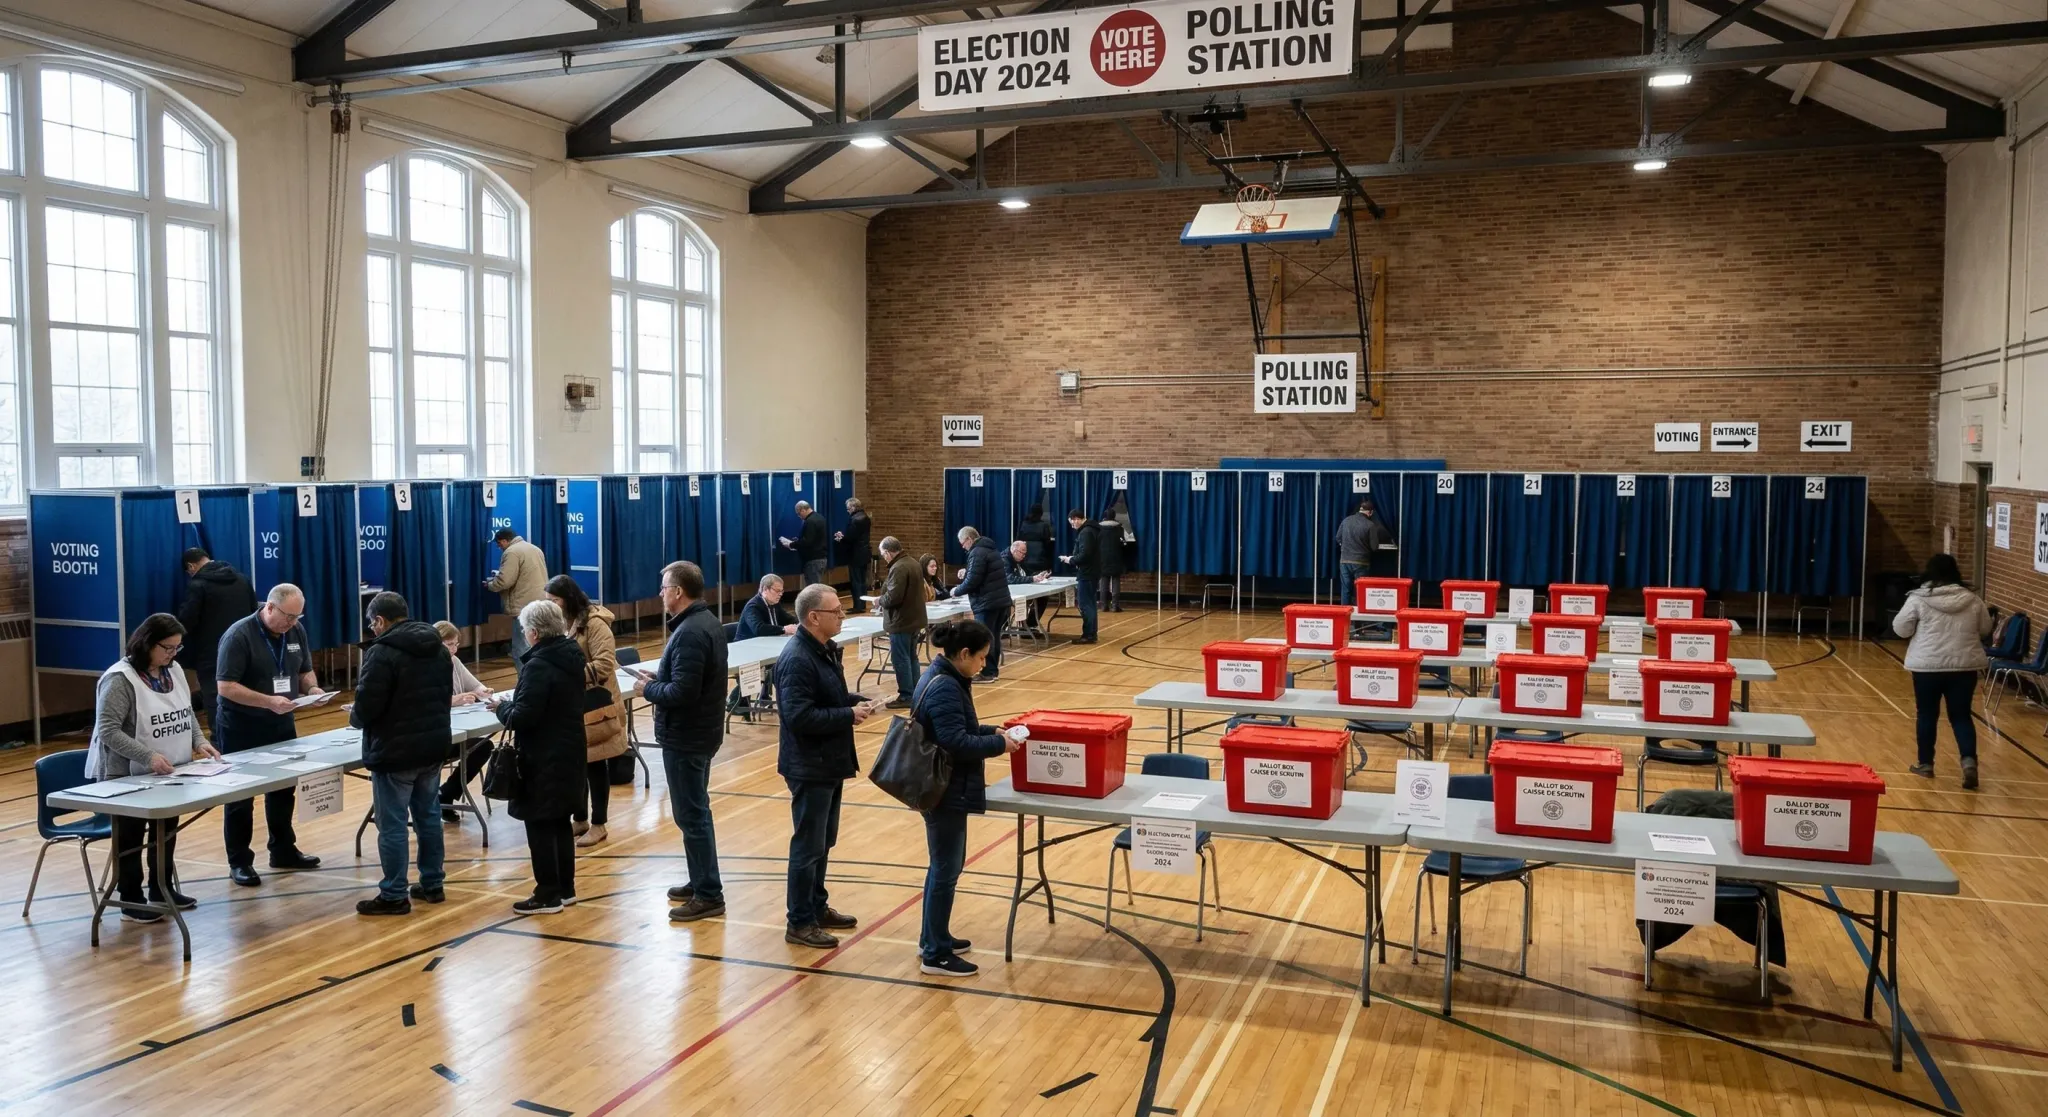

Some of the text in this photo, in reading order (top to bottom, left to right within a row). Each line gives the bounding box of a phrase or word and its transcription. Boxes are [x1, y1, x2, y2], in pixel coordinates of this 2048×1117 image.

[1187, 0, 1334, 40] POLLING
[1100, 24, 1156, 48] VOTE
[934, 26, 1070, 66] ELECTION
[1100, 44, 1156, 72] HERE
[1188, 32, 1332, 75] STATION
[934, 59, 1070, 97] DAY 2024
[1262, 360, 1348, 381] POLLING
[1262, 386, 1347, 406] STATION
[944, 420, 981, 430] VOTING
[1811, 424, 1842, 436] EXIT
[1656, 431, 1699, 442] VOTING
[1713, 427, 1757, 436] ENTRANCE
[972, 473, 983, 482] 14
[1044, 474, 1054, 484] 15
[1114, 475, 1126, 484] 16
[1192, 477, 1204, 486] 17
[1270, 477, 1282, 487] 18
[1354, 478, 1368, 488] 19
[630, 483, 638, 494] 16
[1438, 478, 1452, 489] 20
[1526, 479, 1539, 490] 21
[1618, 480, 1634, 491] 22
[1713, 481, 1730, 492] 23
[1806, 482, 1824, 493] 24
[400, 490, 407, 503] 3
[486, 488, 493, 501] 4
[560, 486, 565, 497] 5
[184, 498, 191, 514] 1
[304, 494, 312, 508] 2
[492, 518, 511, 528] ING
[360, 526, 386, 536] VOTI
[51, 542, 99, 557] VOTING
[360, 540, 386, 550] BOO
[53, 560, 98, 575] BOOTH
[152, 721, 191, 738] OFFICIAL
[1664, 907, 1684, 916] 2024
